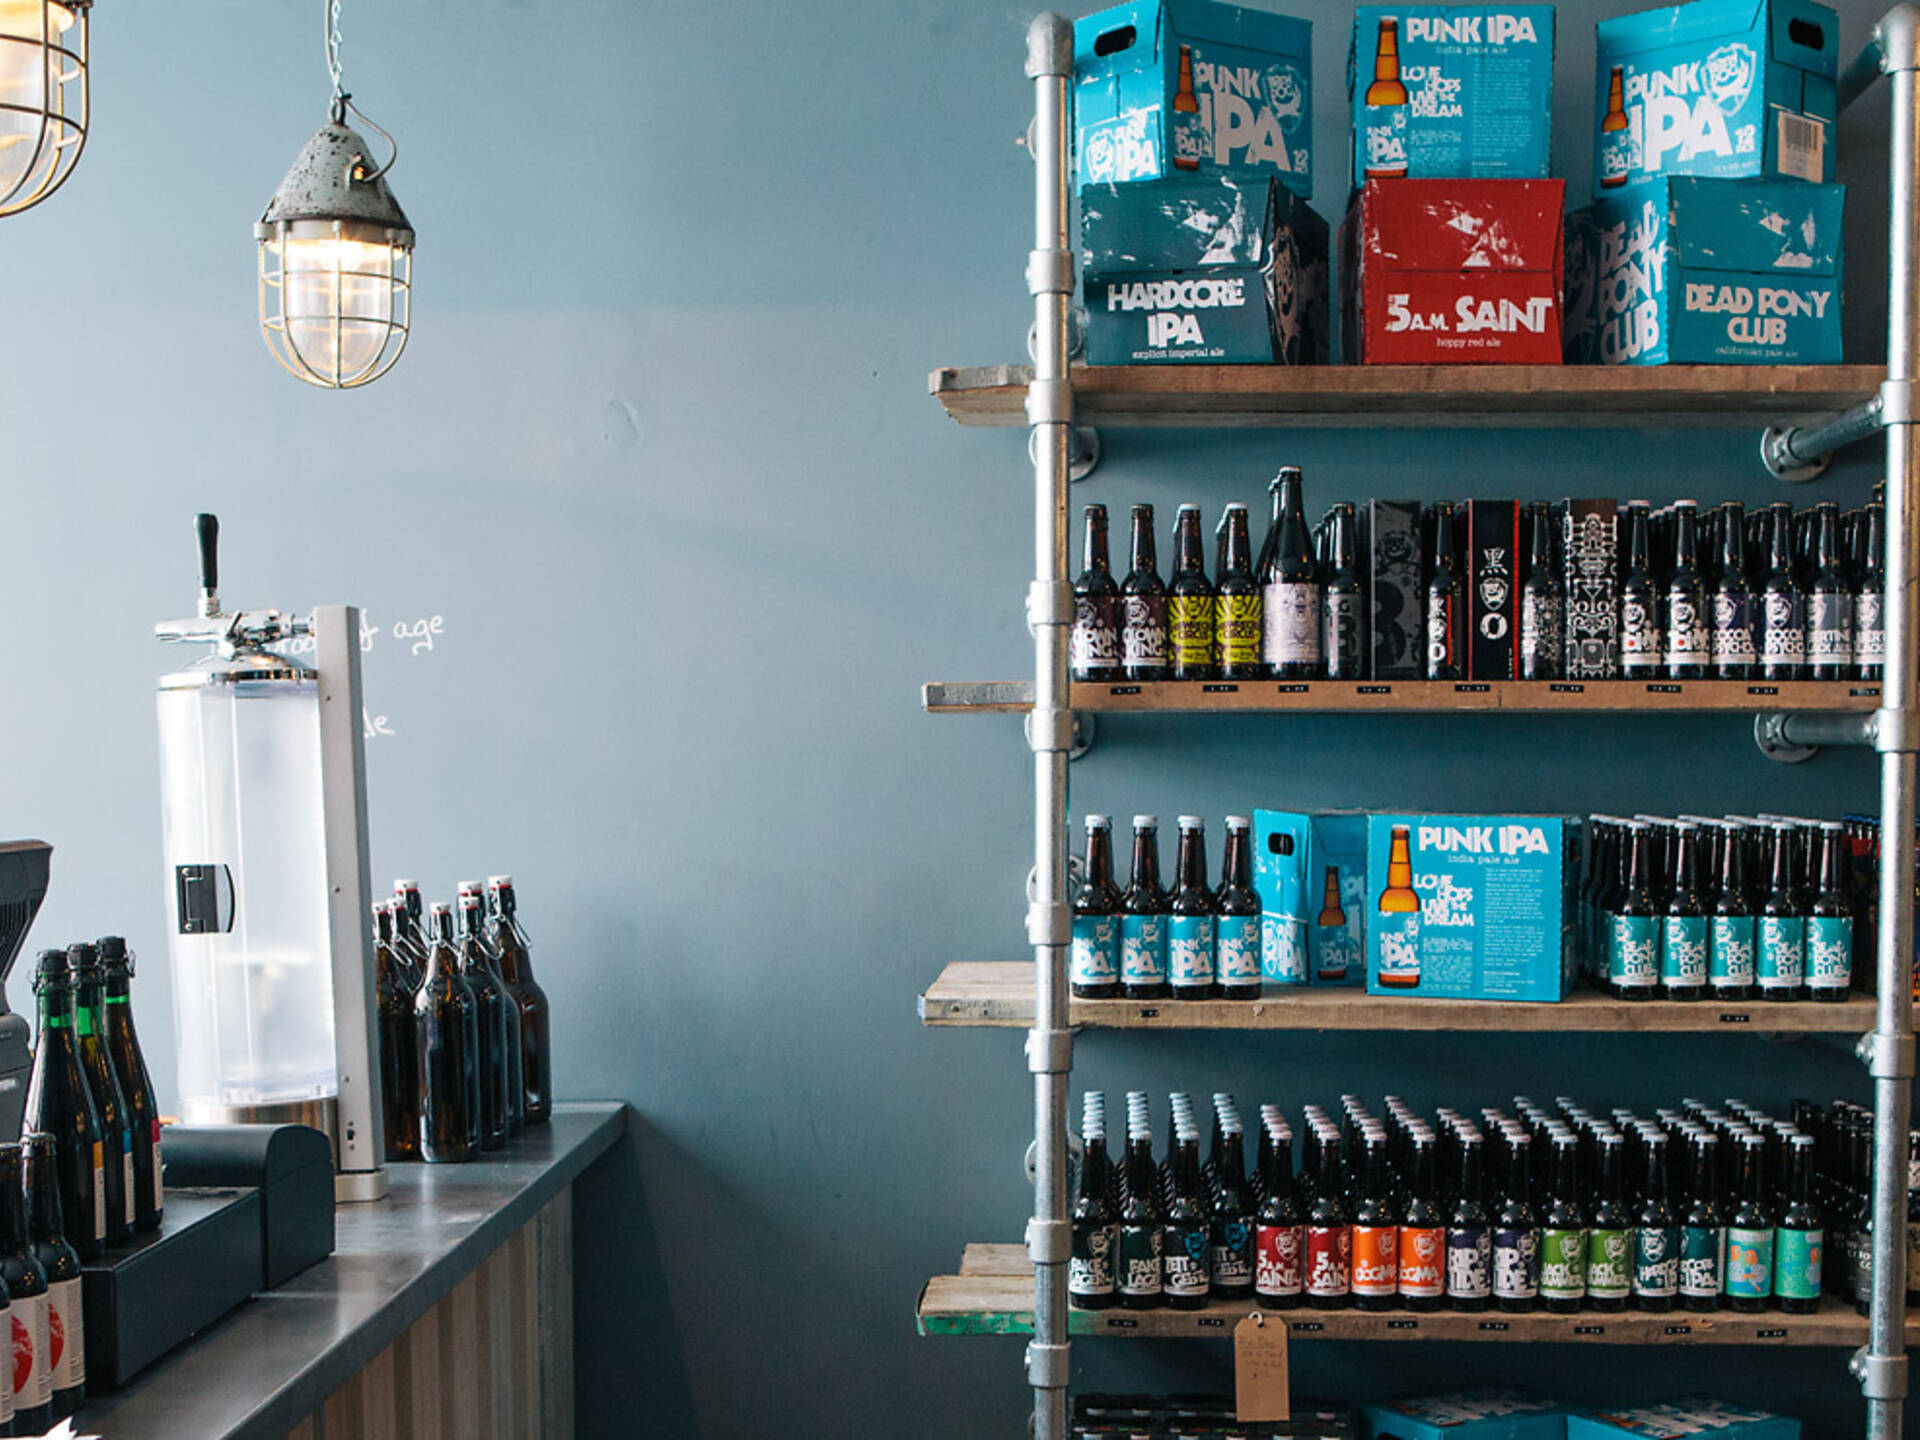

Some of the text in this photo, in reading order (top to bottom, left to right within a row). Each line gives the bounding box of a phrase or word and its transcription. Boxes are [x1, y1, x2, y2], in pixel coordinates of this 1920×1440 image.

[1406, 15, 1538, 44] PUNK IPA
[1195, 62, 1263, 99] PUNK
[1402, 66, 1441, 82] LOVE
[1425, 78, 1462, 93] HOPS
[1626, 61, 1701, 103] PUNK
[1409, 91, 1437, 106] LIVE
[1411, 103, 1463, 118] DREAM
[1199, 92, 1292, 172] IPA
[1628, 97, 1734, 173] IPA
[1735, 124, 1755, 144] 12
[1602, 199, 1660, 270] DEAD
[1599, 240, 1668, 316] PONY
[1107, 278, 1245, 312] HARDCORE
[1685, 283, 1831, 318] DEAD PONY
[1455, 295, 1553, 333] SAINT
[1147, 312, 1204, 348] IPA
[1436, 337, 1501, 349] hoppy red ale
[1600, 298, 1660, 365] CLUB
[1727, 316, 1787, 346] CLUB
[392, 615, 445, 655] age
[1418, 825, 1550, 855] PUNK IPA
[1448, 855, 1520, 865] india pale ale
[1414, 873, 1454, 889] LOVE
[1437, 887, 1473, 902] HOPS
[1421, 898, 1449, 912] LIVE
[1424, 911, 1475, 927] DREAM
